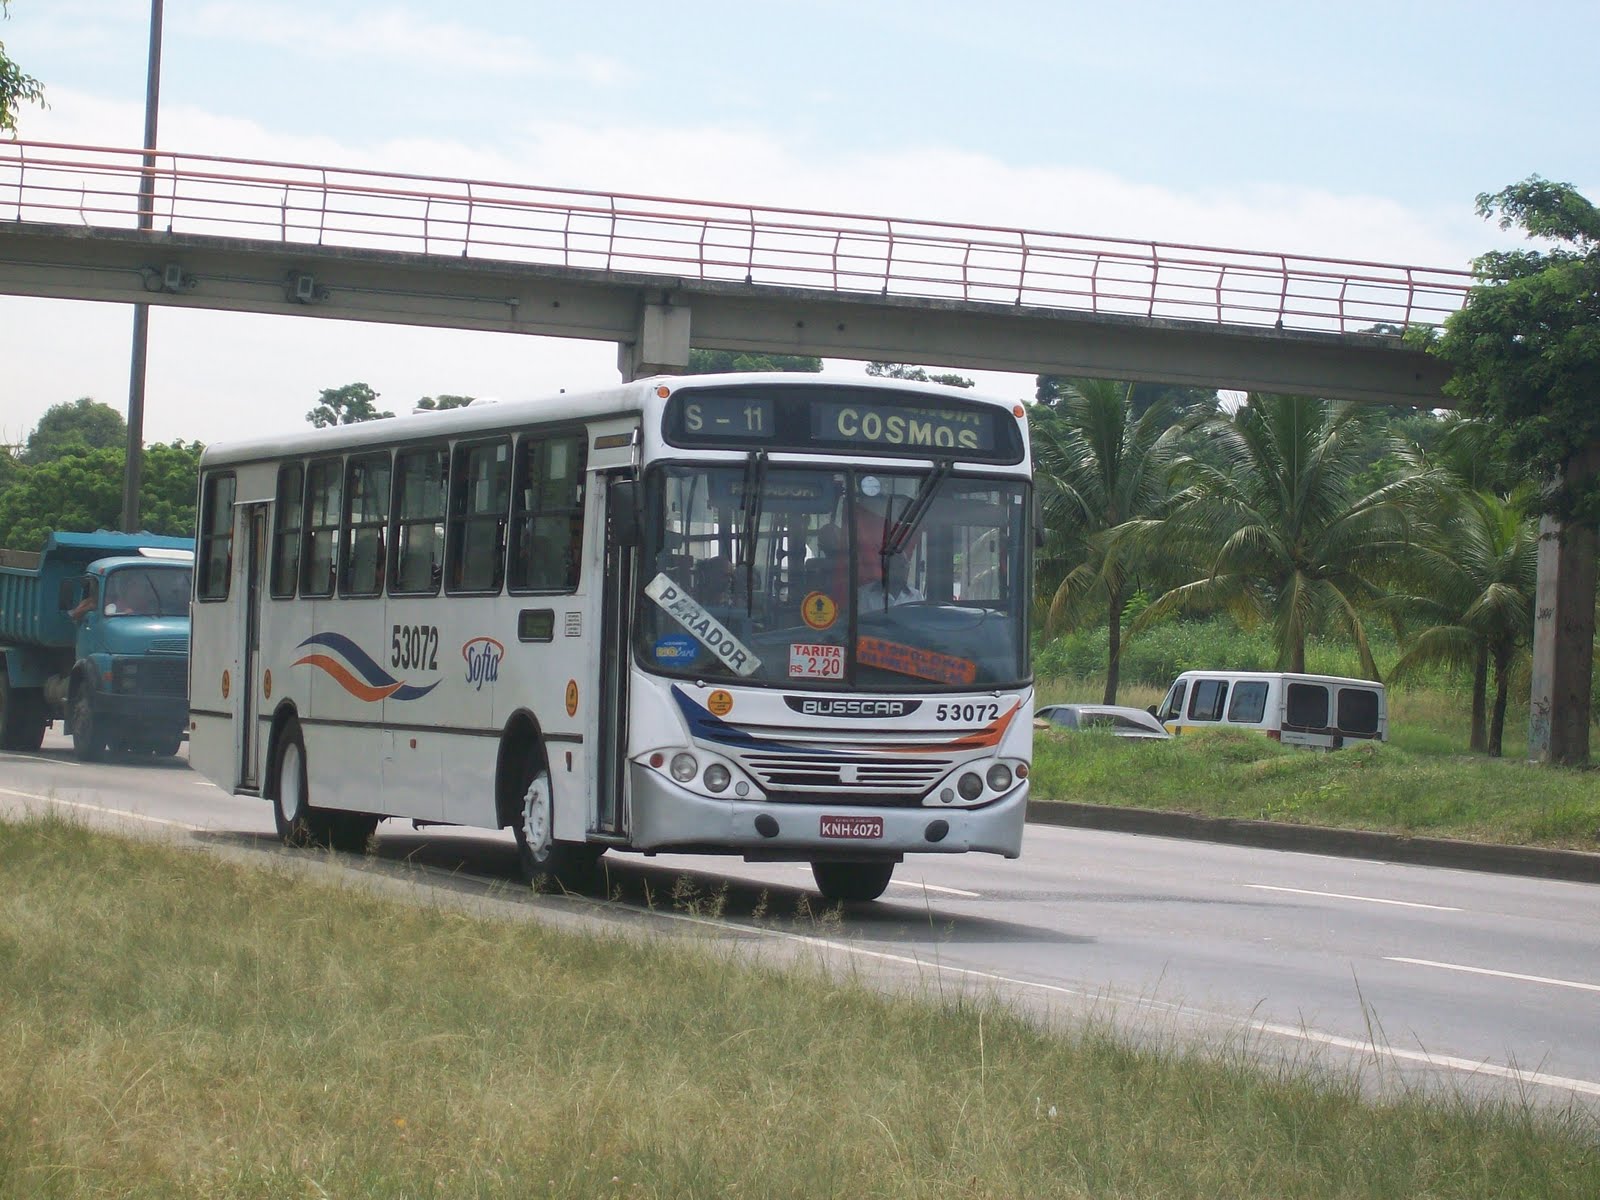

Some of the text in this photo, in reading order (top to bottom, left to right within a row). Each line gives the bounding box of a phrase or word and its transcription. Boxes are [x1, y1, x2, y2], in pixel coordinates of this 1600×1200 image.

[837, 408, 978, 449] COSMOS
[659, 586, 748, 671] PARADOR
[391, 624, 439, 671] 53072
[794, 645, 841, 658] TARIFA
[465, 642, 499, 692] Sofia
[807, 657, 840, 676] 2,20
[802, 700, 904, 715] BUSSCAR
[935, 703, 1000, 722] 53072
